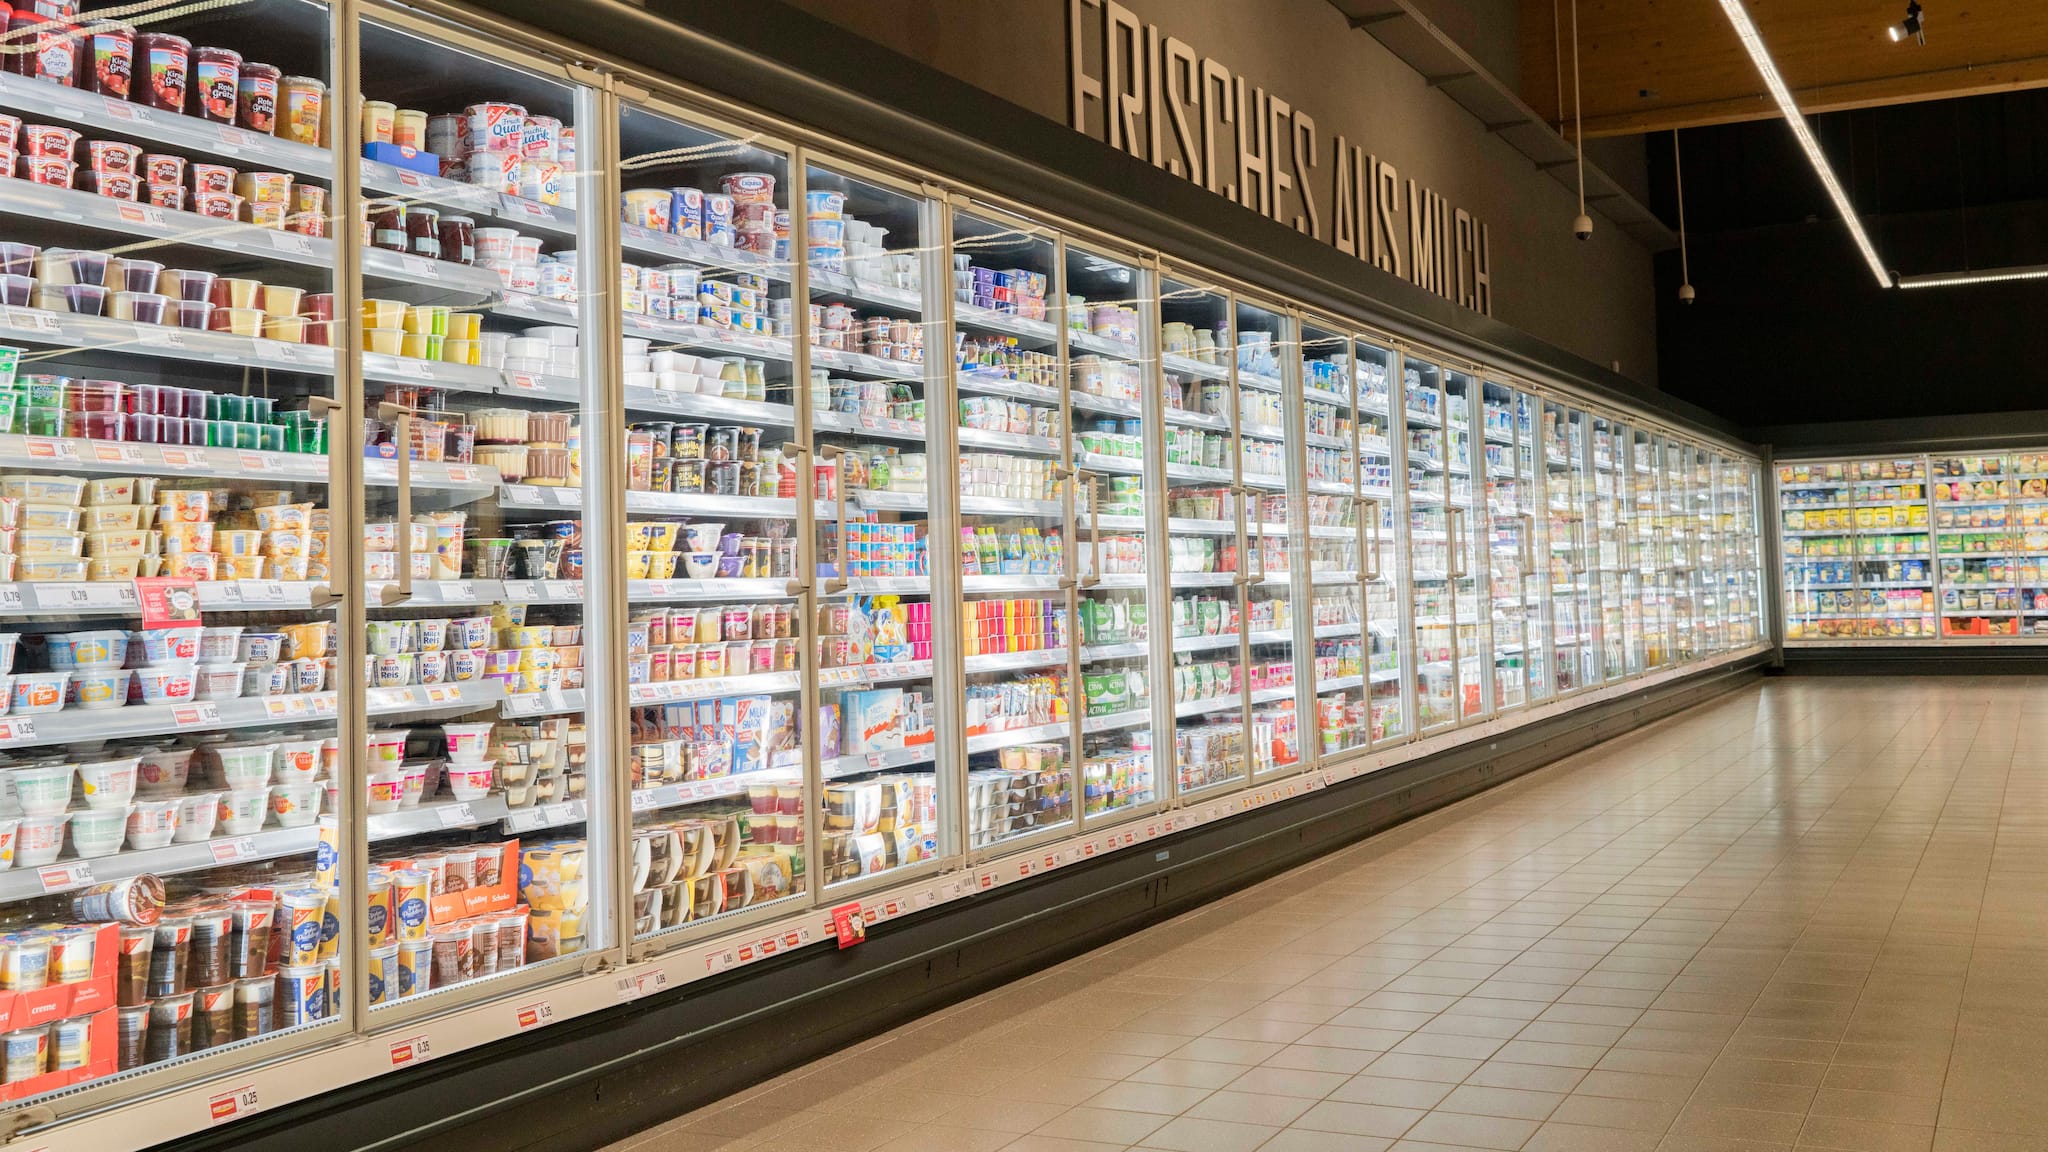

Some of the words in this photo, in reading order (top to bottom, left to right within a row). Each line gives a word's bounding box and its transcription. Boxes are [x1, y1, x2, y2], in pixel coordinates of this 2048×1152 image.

[493, 124, 520, 136] Quar
[1069, 0, 1319, 240] FRISCHES
[1334, 135, 1401, 278] AUS
[1407, 178, 1492, 318] MILCH
[546, 182, 560, 194] Qua
[3, 591, 21, 602] 0.79
[72, 590, 88, 601] 0.79
[120, 589, 135, 600] 0.79
[381, 671, 399, 679] Reis
[456, 665, 473, 673] Reis
[301, 677, 319, 685] Reis
[203, 707, 219, 719] 0.29
[18, 723, 35, 734] 0.29
[76, 867, 92, 879] 0.29
[31, 1003, 57, 1015] creme
[540, 1006, 552, 1018] 0.35
[417, 1041, 430, 1054] 0.35
[242, 1091, 258, 1106] 0.25
